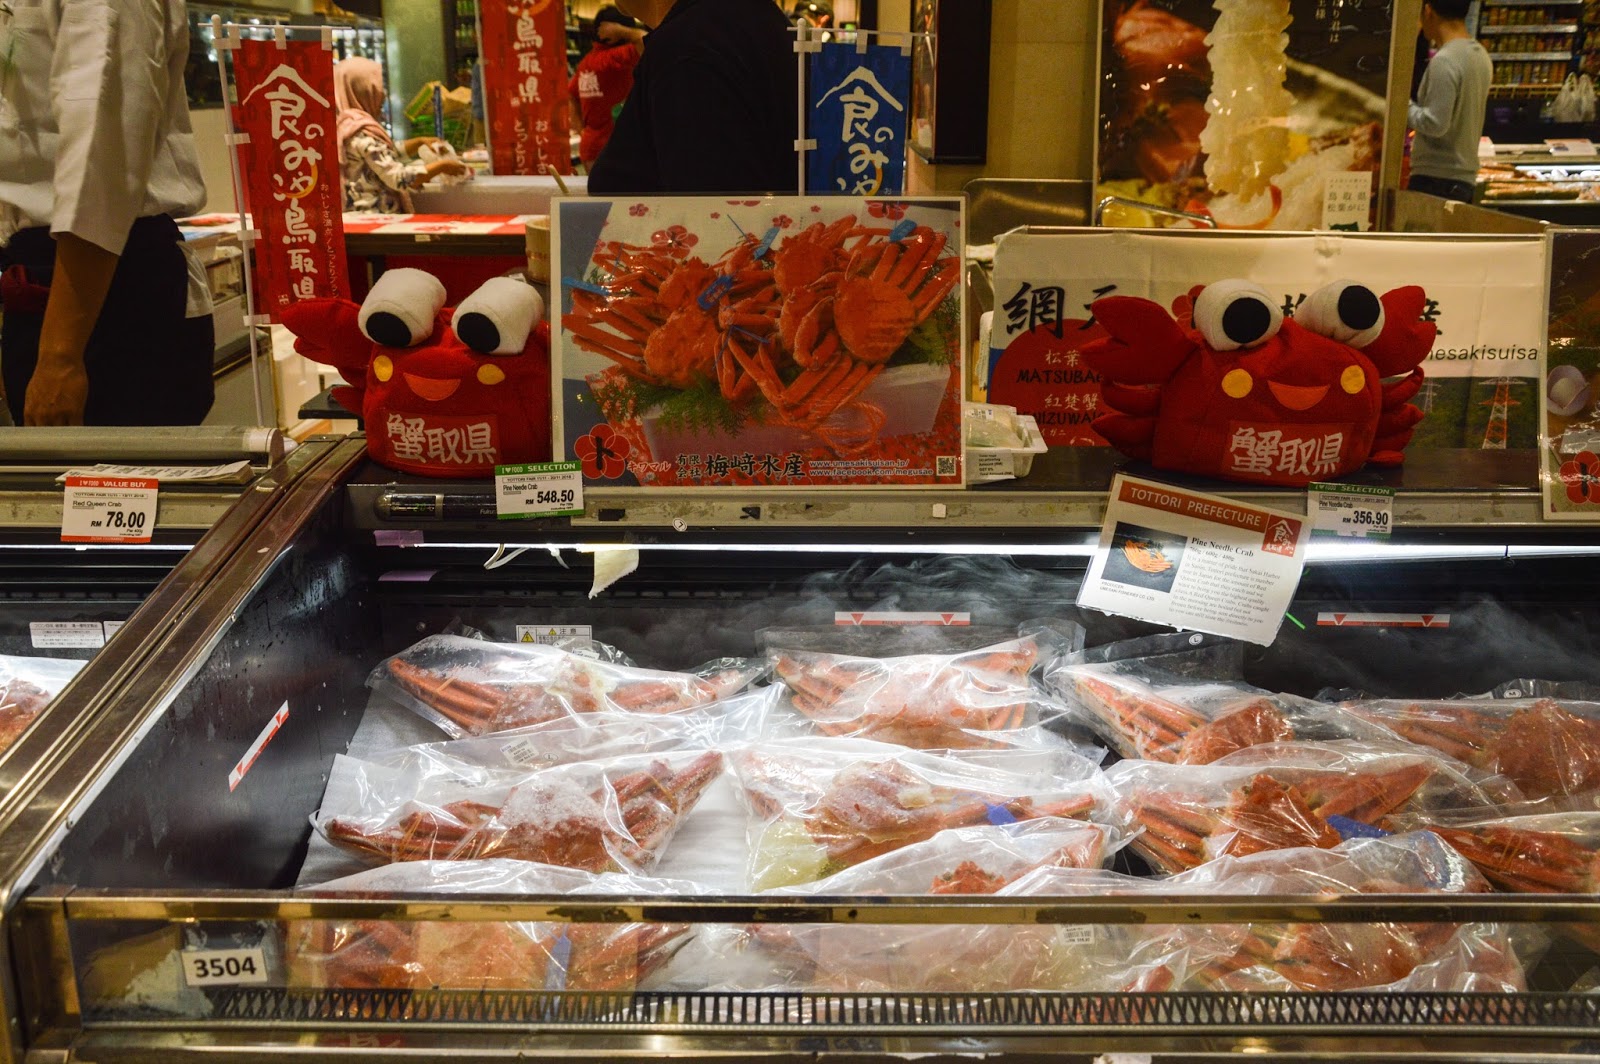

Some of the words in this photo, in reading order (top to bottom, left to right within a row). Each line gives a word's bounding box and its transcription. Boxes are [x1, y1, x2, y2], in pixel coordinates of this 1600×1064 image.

[513, 0, 543, 103] 鳥取県
[386, 413, 496, 464] 蟹取県
[1230, 427, 1343, 476] 蟹取県
[528, 463, 575, 472] SELECTION
[537, 490, 574, 504] 548.50
[1342, 486, 1389, 494] SELECTION
[1130, 487, 1182, 508] TOTTORI
[1187, 500, 1262, 527] PREFECTURE
[106, 511, 145, 528] 78.00
[1353, 511, 1388, 525] 356.90
[1191, 538, 1207, 546] Pine
[1208, 541, 1233, 552] Needle
[1235, 547, 1254, 556] Crab
[194, 956, 257, 978] 3504
